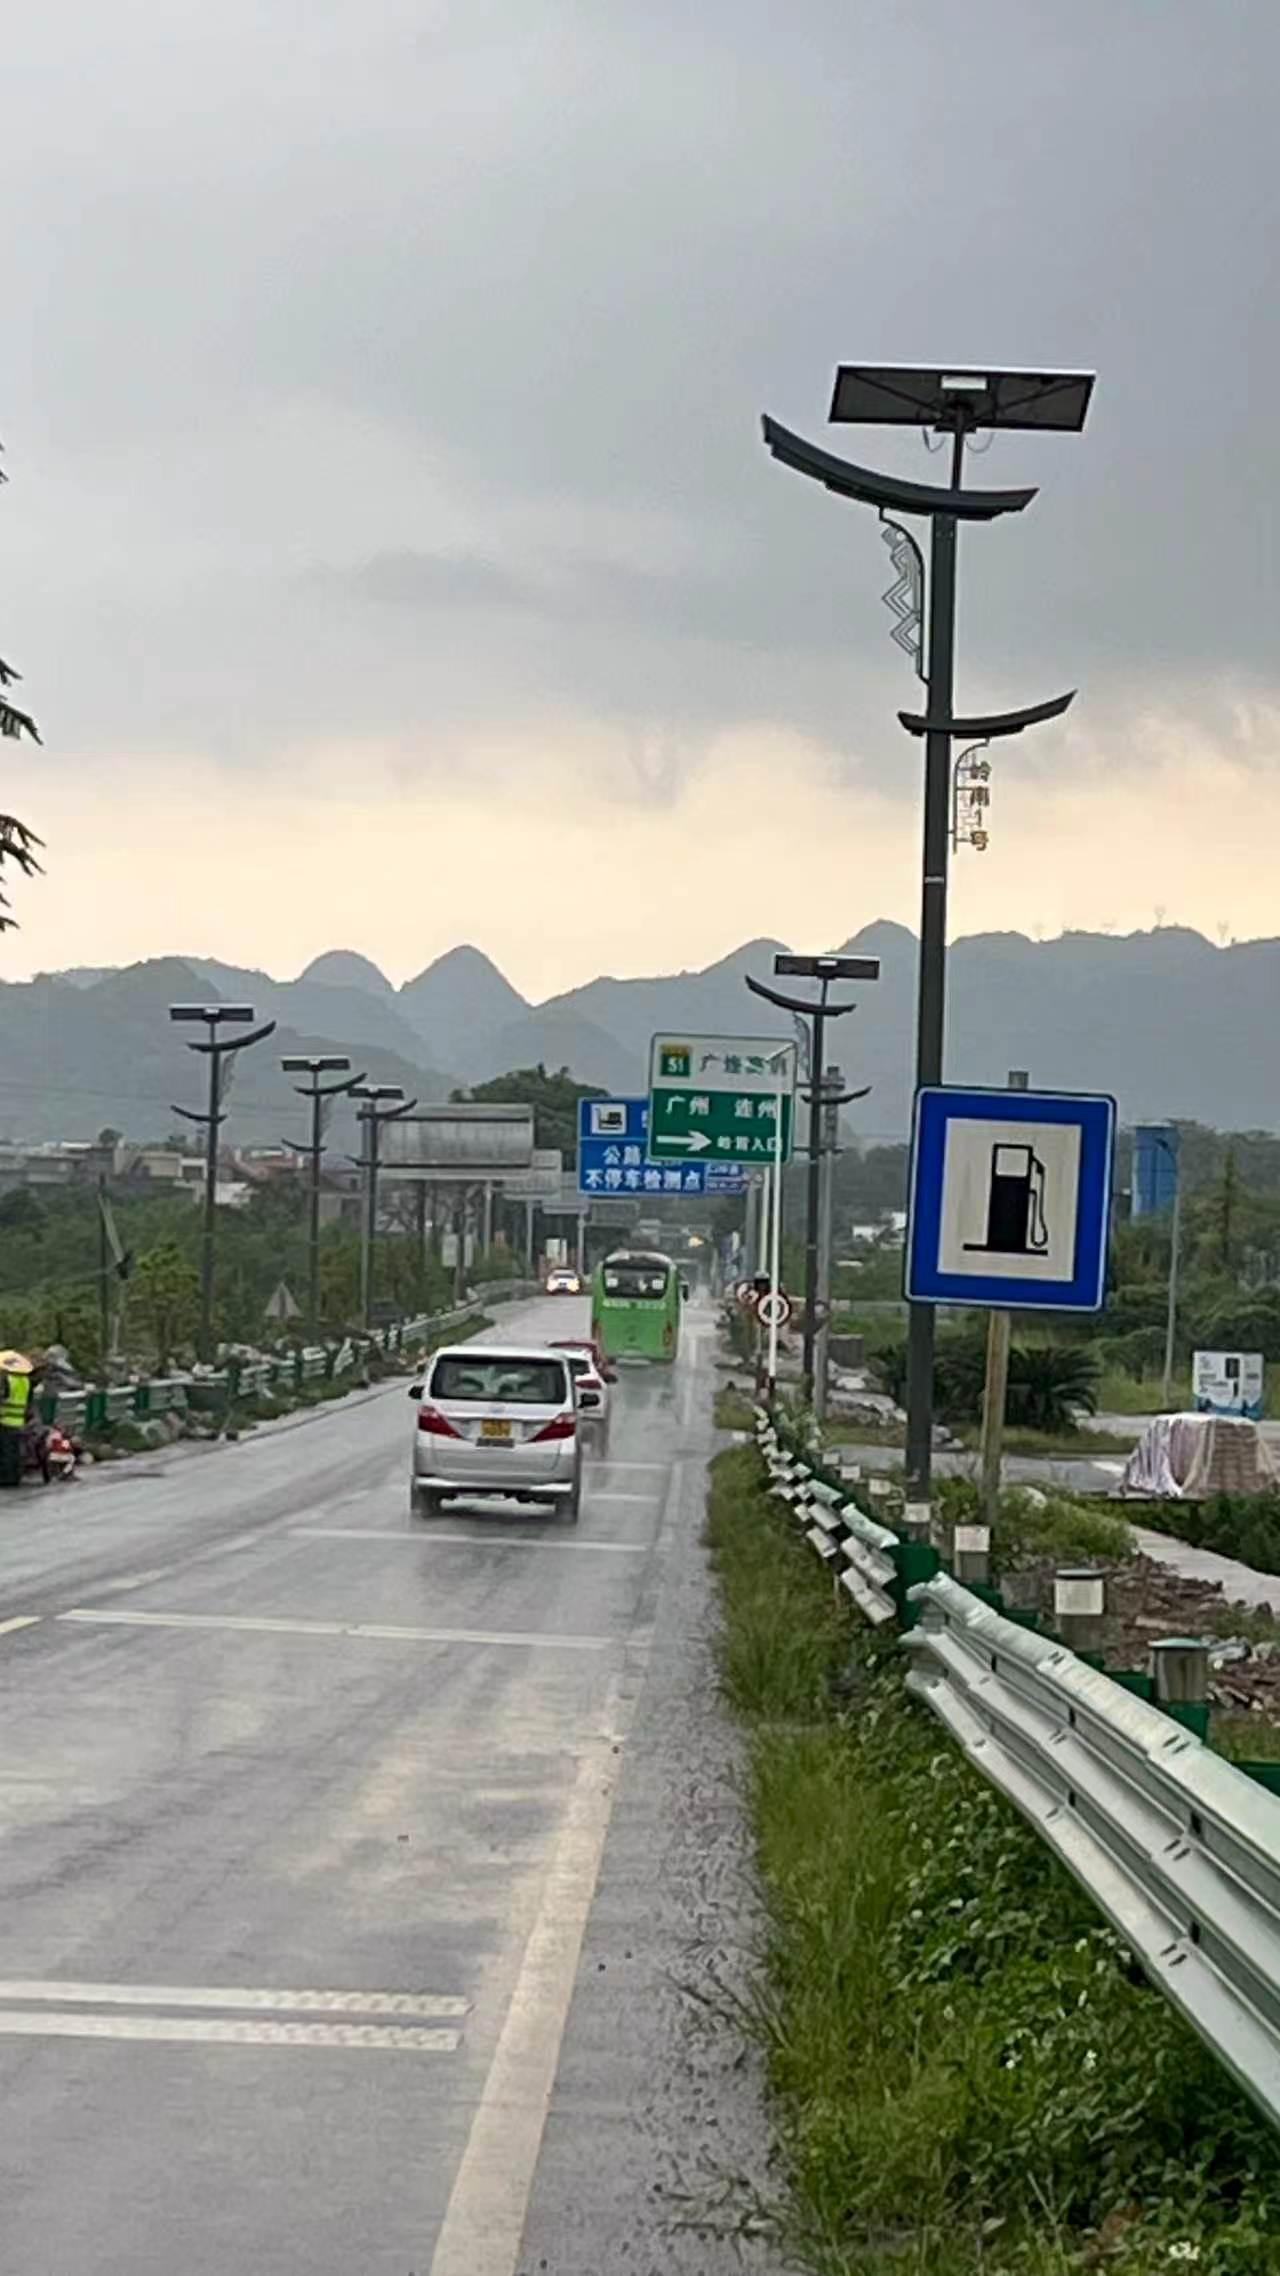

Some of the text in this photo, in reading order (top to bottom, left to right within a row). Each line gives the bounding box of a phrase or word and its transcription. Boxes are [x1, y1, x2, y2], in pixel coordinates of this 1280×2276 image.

[665, 1095, 710, 1116] 广州
[585, 1167, 701, 1190] 不停车检测点
